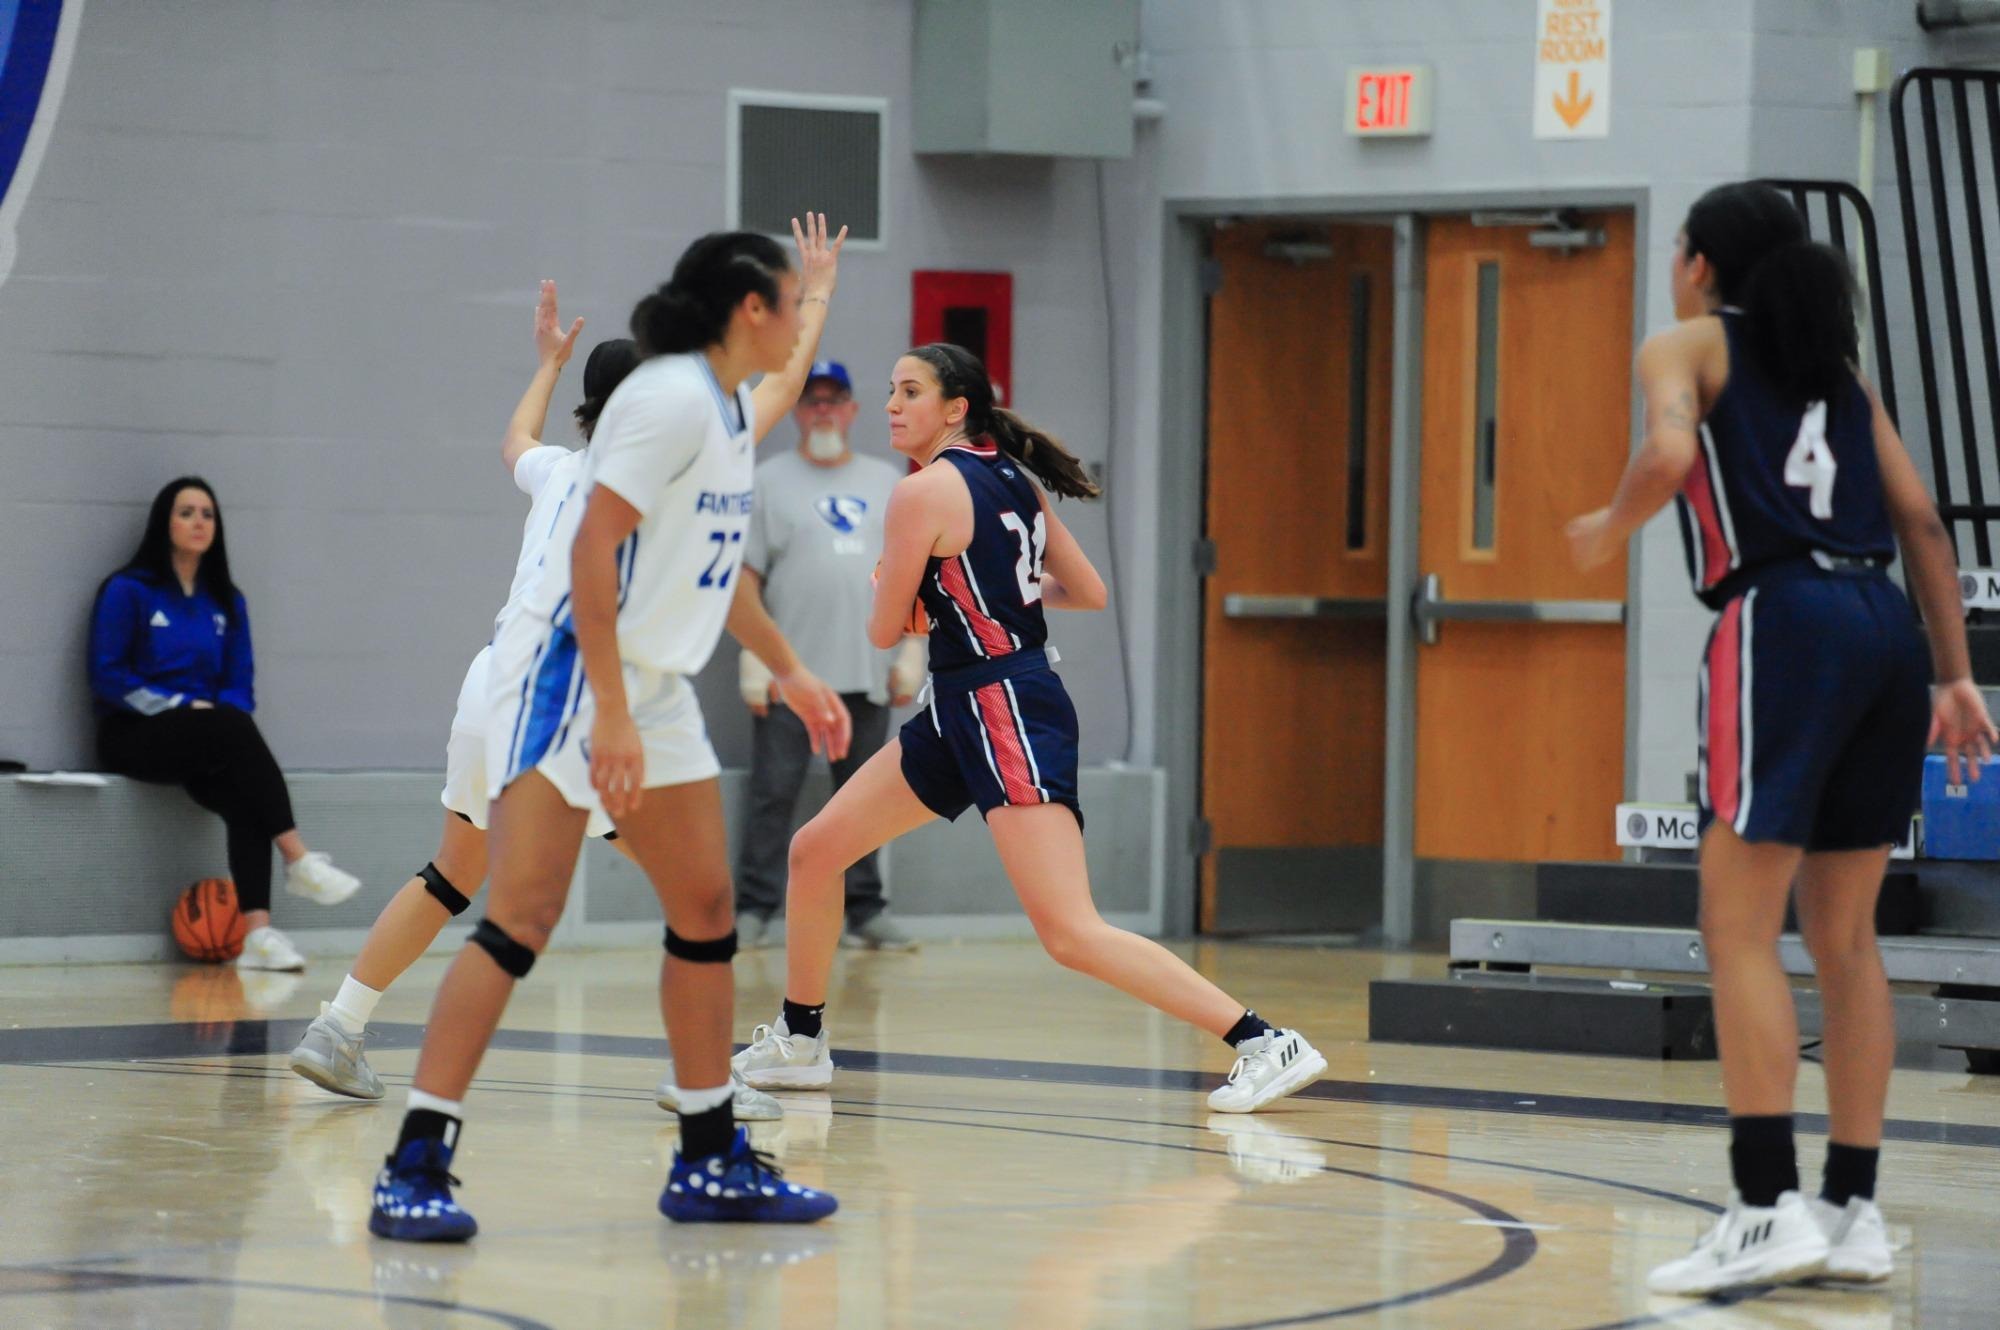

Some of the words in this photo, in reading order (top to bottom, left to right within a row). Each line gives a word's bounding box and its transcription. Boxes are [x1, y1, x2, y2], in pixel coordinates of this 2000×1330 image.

[1546, 11, 1600, 34] REST
[1541, 39, 1605, 62] ROOM
[1357, 73, 1413, 128] EXIT
[1784, 400, 1837, 519] 4
